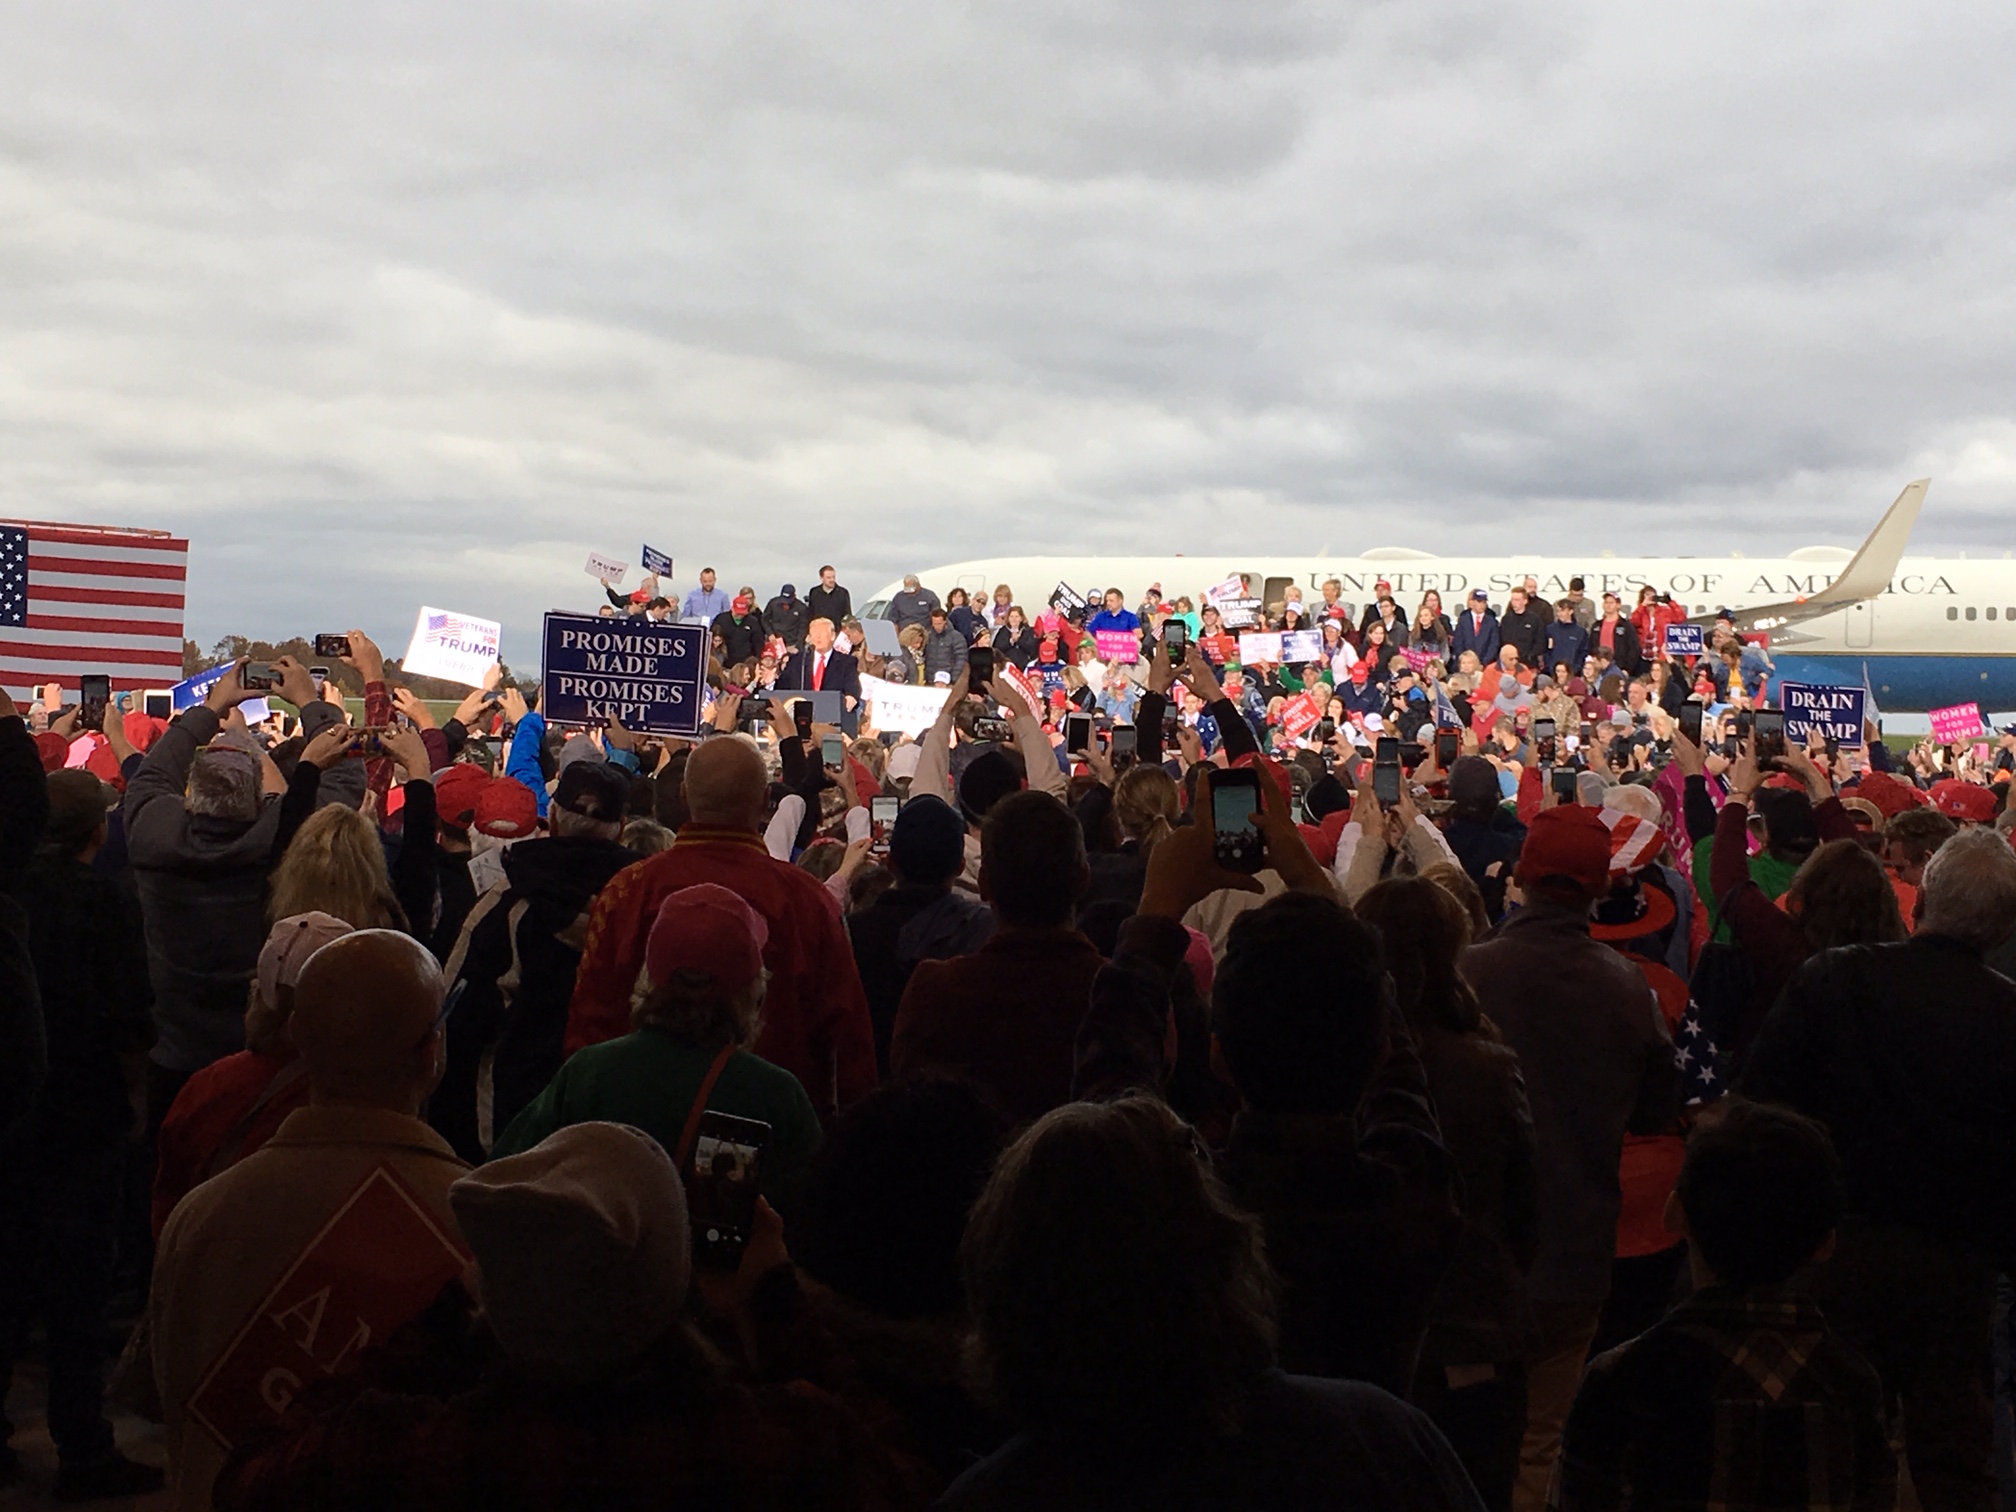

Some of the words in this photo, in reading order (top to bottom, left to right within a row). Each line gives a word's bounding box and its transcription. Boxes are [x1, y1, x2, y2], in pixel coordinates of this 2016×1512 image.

[592, 559, 623, 573] TRUMP
[1669, 573, 1723, 594] OF
[1747, 574, 1957, 594] AMICA
[1057, 583, 1085, 609] TRUMP
[1220, 600, 1262, 610] TRUMP
[1053, 600, 1070, 619] COAL
[459, 621, 498, 637] VETERANS
[1228, 615, 1254, 625] COAL
[482, 636, 497, 645] FOR
[1097, 632, 1138, 642] WOMEN
[1669, 628, 1698, 637] DRAIN
[439, 636, 497, 658] TRUMP
[561, 630, 686, 658] PROMISES
[1667, 642, 1701, 651] SWAMP
[585, 653, 659, 675] MADE
[1099, 650, 1135, 660] TRUMP
[559, 677, 684, 704] PROMISES
[1283, 697, 1309, 722] FINISH
[1791, 691, 1854, 710] DRAIN
[586, 700, 651, 722] KEPT
[1808, 709, 1832, 721] THE
[1929, 705, 1978, 723] WOMEN
[1286, 711, 1316, 732] WALL
[1788, 720, 1857, 739] SWAMP
[1945, 719, 1964, 729] FOR
[1937, 726, 1980, 742] TRUMP
